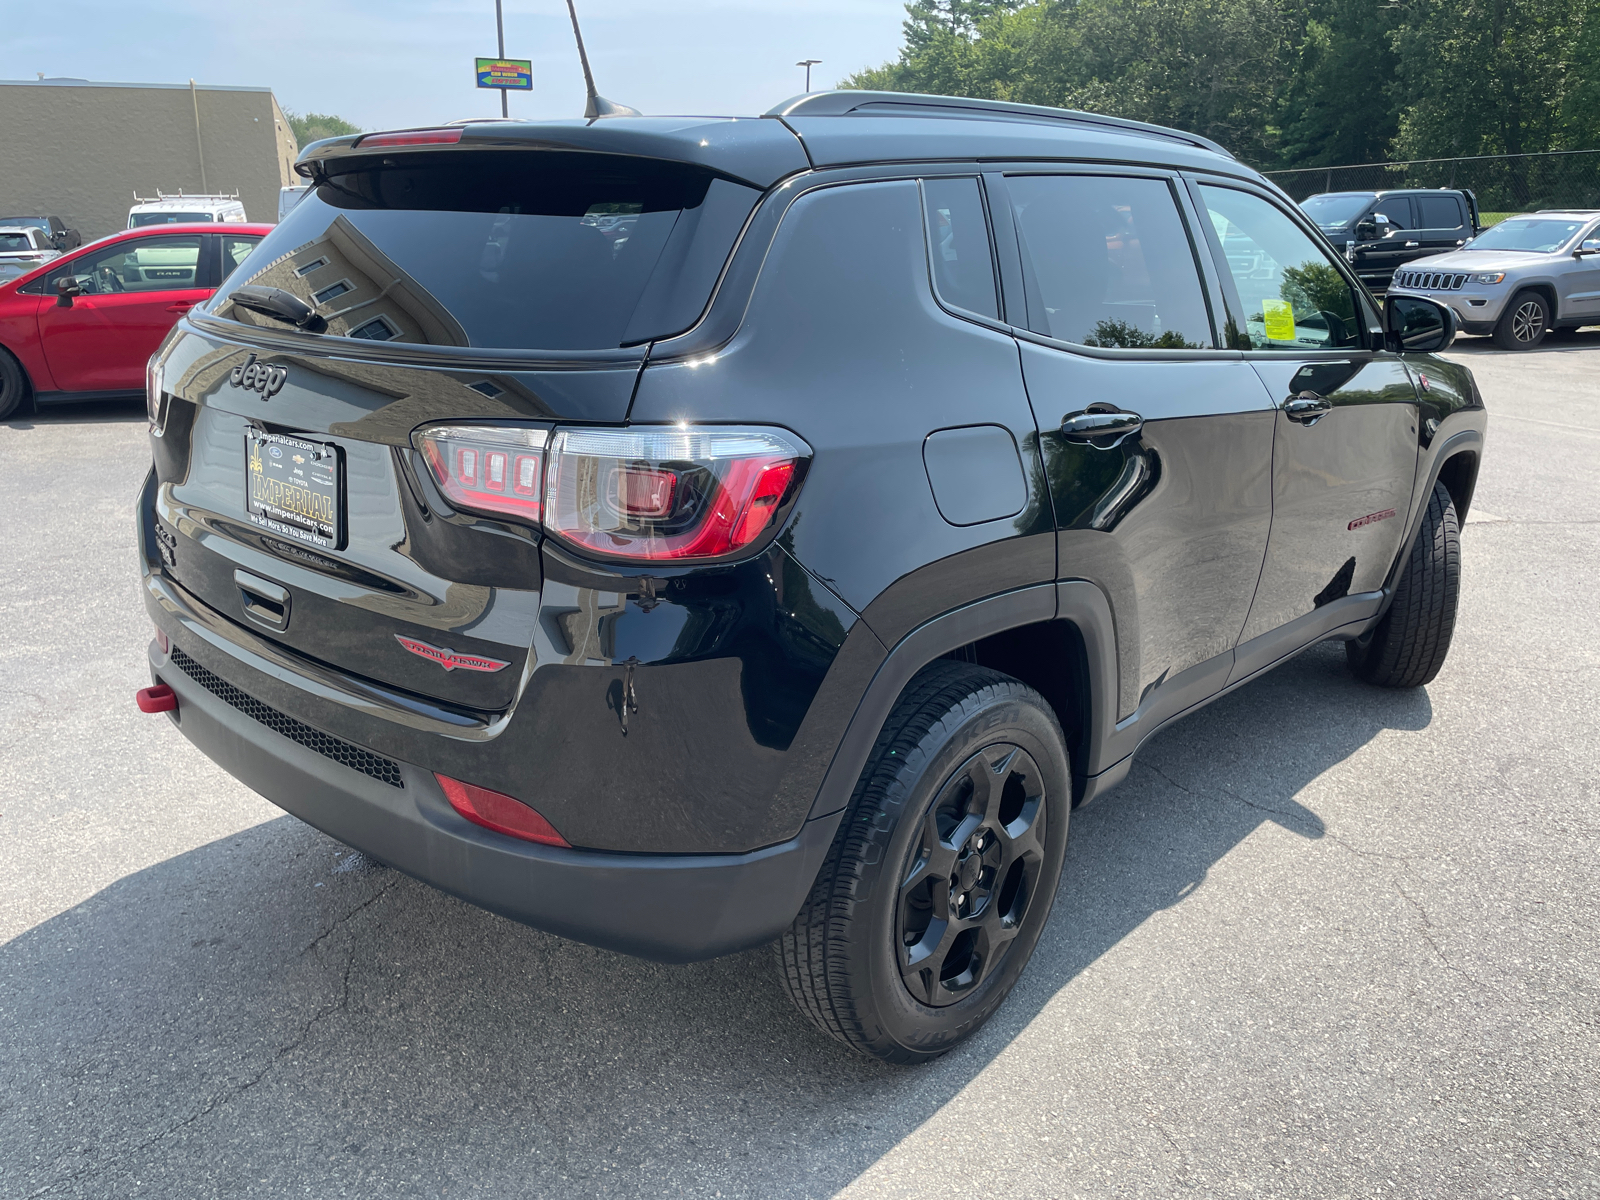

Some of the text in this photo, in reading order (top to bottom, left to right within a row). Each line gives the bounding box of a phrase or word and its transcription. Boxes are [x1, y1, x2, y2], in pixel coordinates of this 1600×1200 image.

[230, 352, 288, 402] Jeep
[259, 431, 314, 452] Imperialcars.com
[293, 467, 304, 478] Jeep
[293, 478, 309, 487] TOYOTA
[253, 474, 333, 524] IMPERIAL
[250, 514, 258, 524] We
[258, 517, 268, 526] Sell
[282, 525, 288, 533] So
[289, 528, 299, 537] You
[300, 531, 312, 541] Save
[313, 535, 327, 546] More
